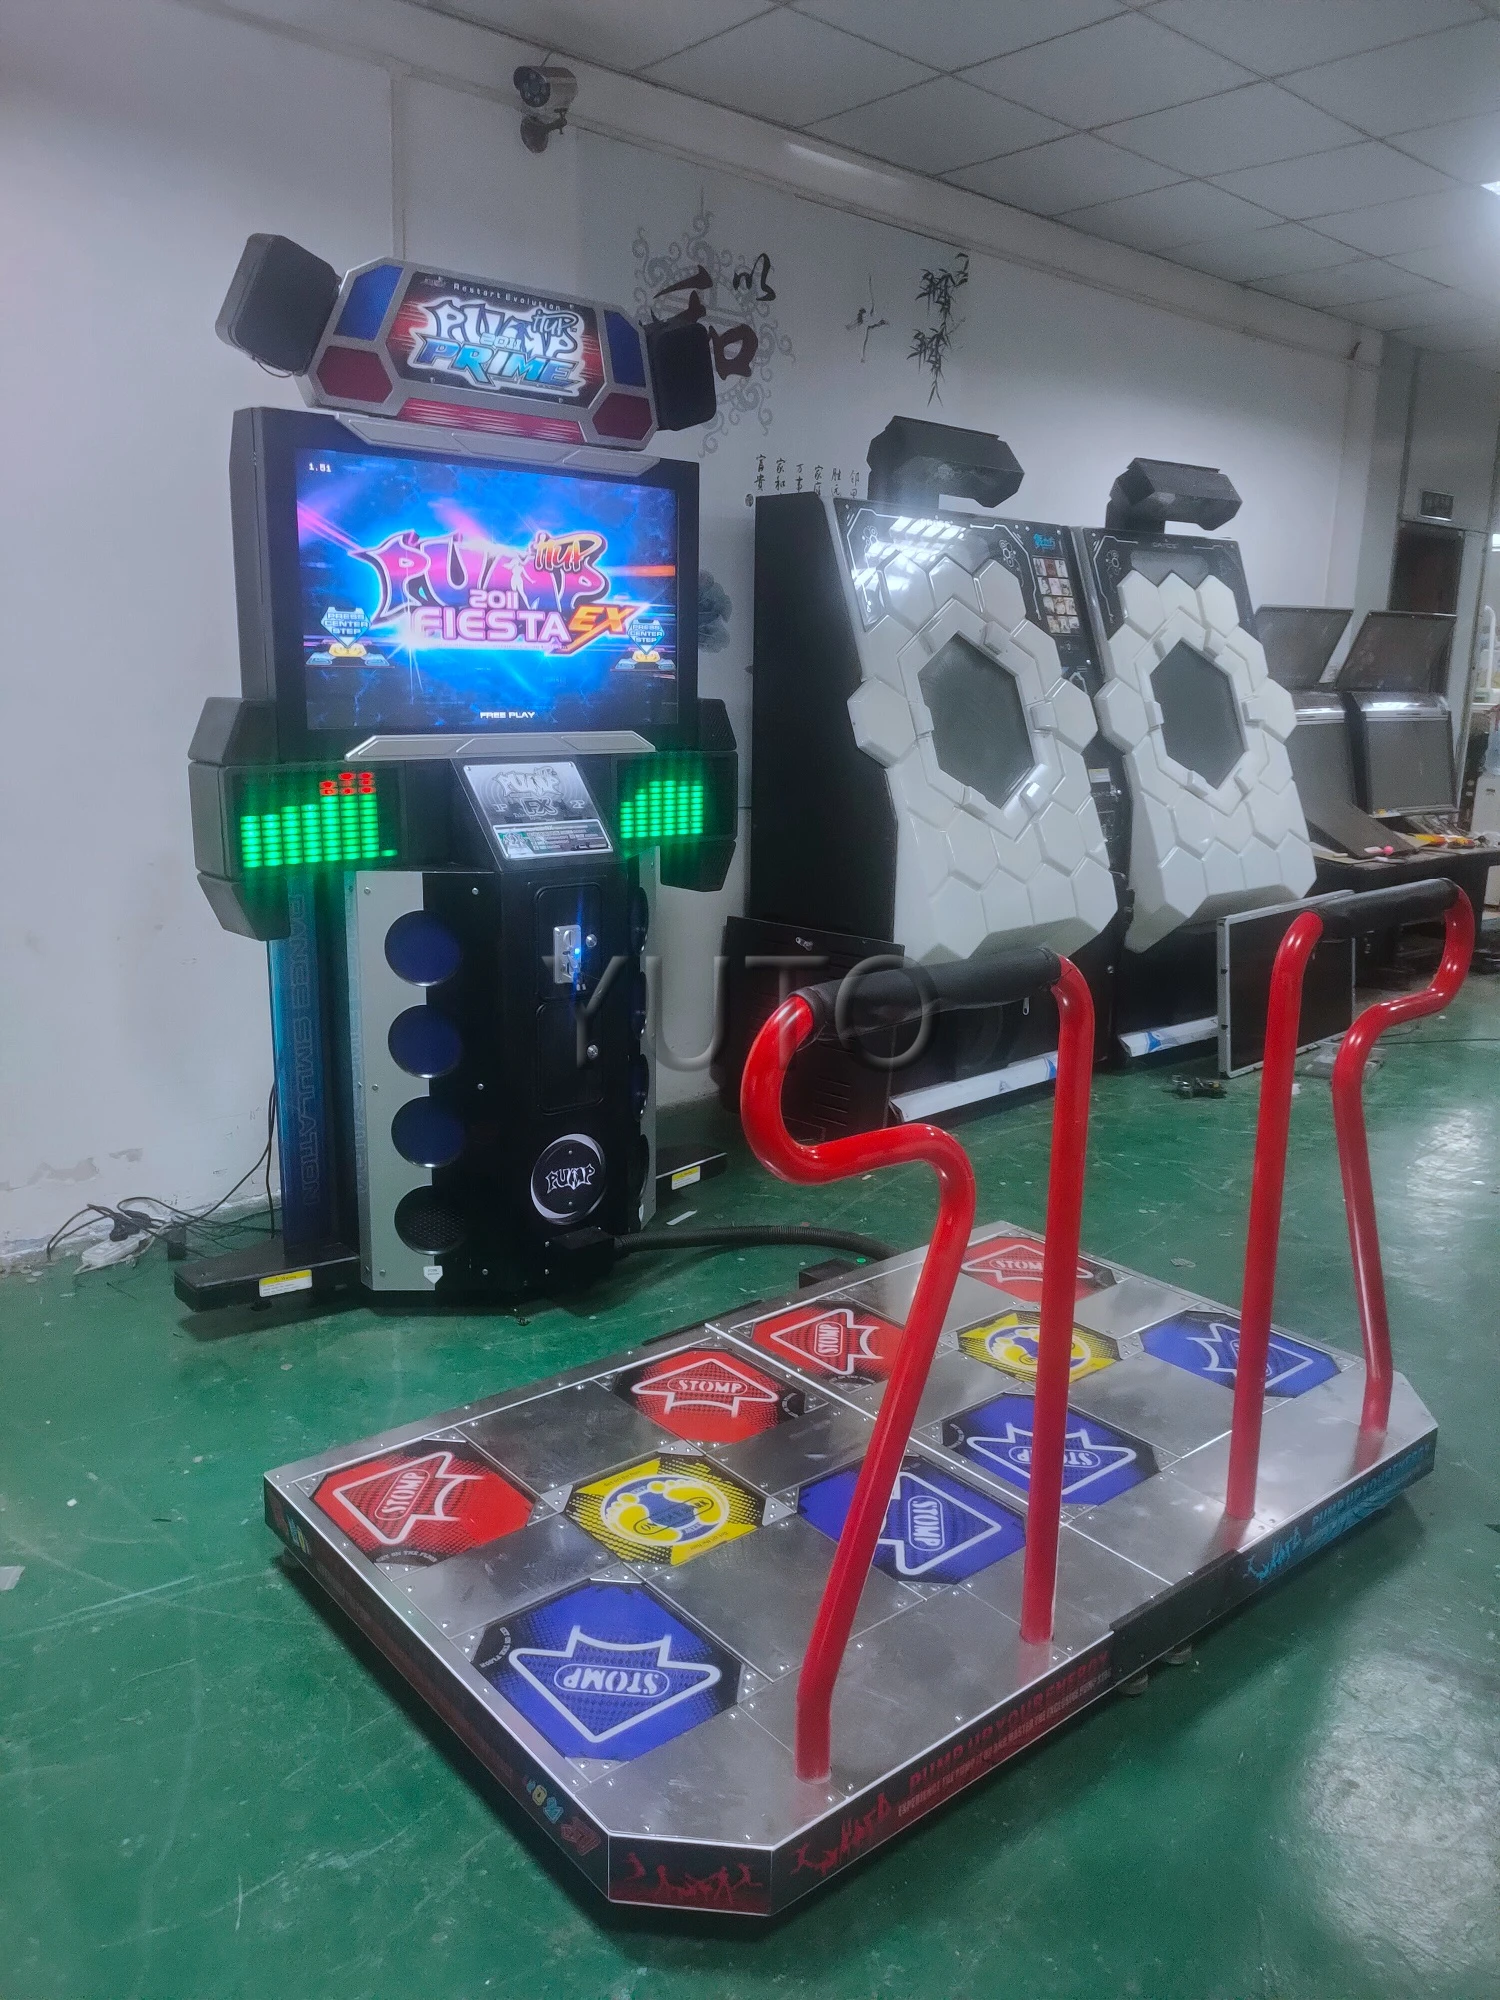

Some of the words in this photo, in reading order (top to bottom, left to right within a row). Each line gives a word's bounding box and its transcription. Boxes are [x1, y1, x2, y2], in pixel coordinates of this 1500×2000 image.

[415, 332, 580, 388] PRIME
[349, 529, 610, 624] PUMP
[469, 589, 519, 609] 2011
[411, 606, 573, 643] FIESTA
[556, 604, 637, 648] EX
[480, 711, 506, 719] FREE
[508, 711, 535, 719] PLAY
[292, 1016, 321, 1207] SIMULATION
[545, 1163, 596, 1194] PUMP
[995, 1259, 1043, 1272] STOM
[817, 1323, 840, 1354] STOMP
[678, 1379, 743, 1394] STOMP
[1017, 1447, 1093, 1467] STP
[381, 1472, 426, 1514] STOMP
[911, 1500, 942, 1547] STOMP
[562, 1667, 661, 1695] STOMP
